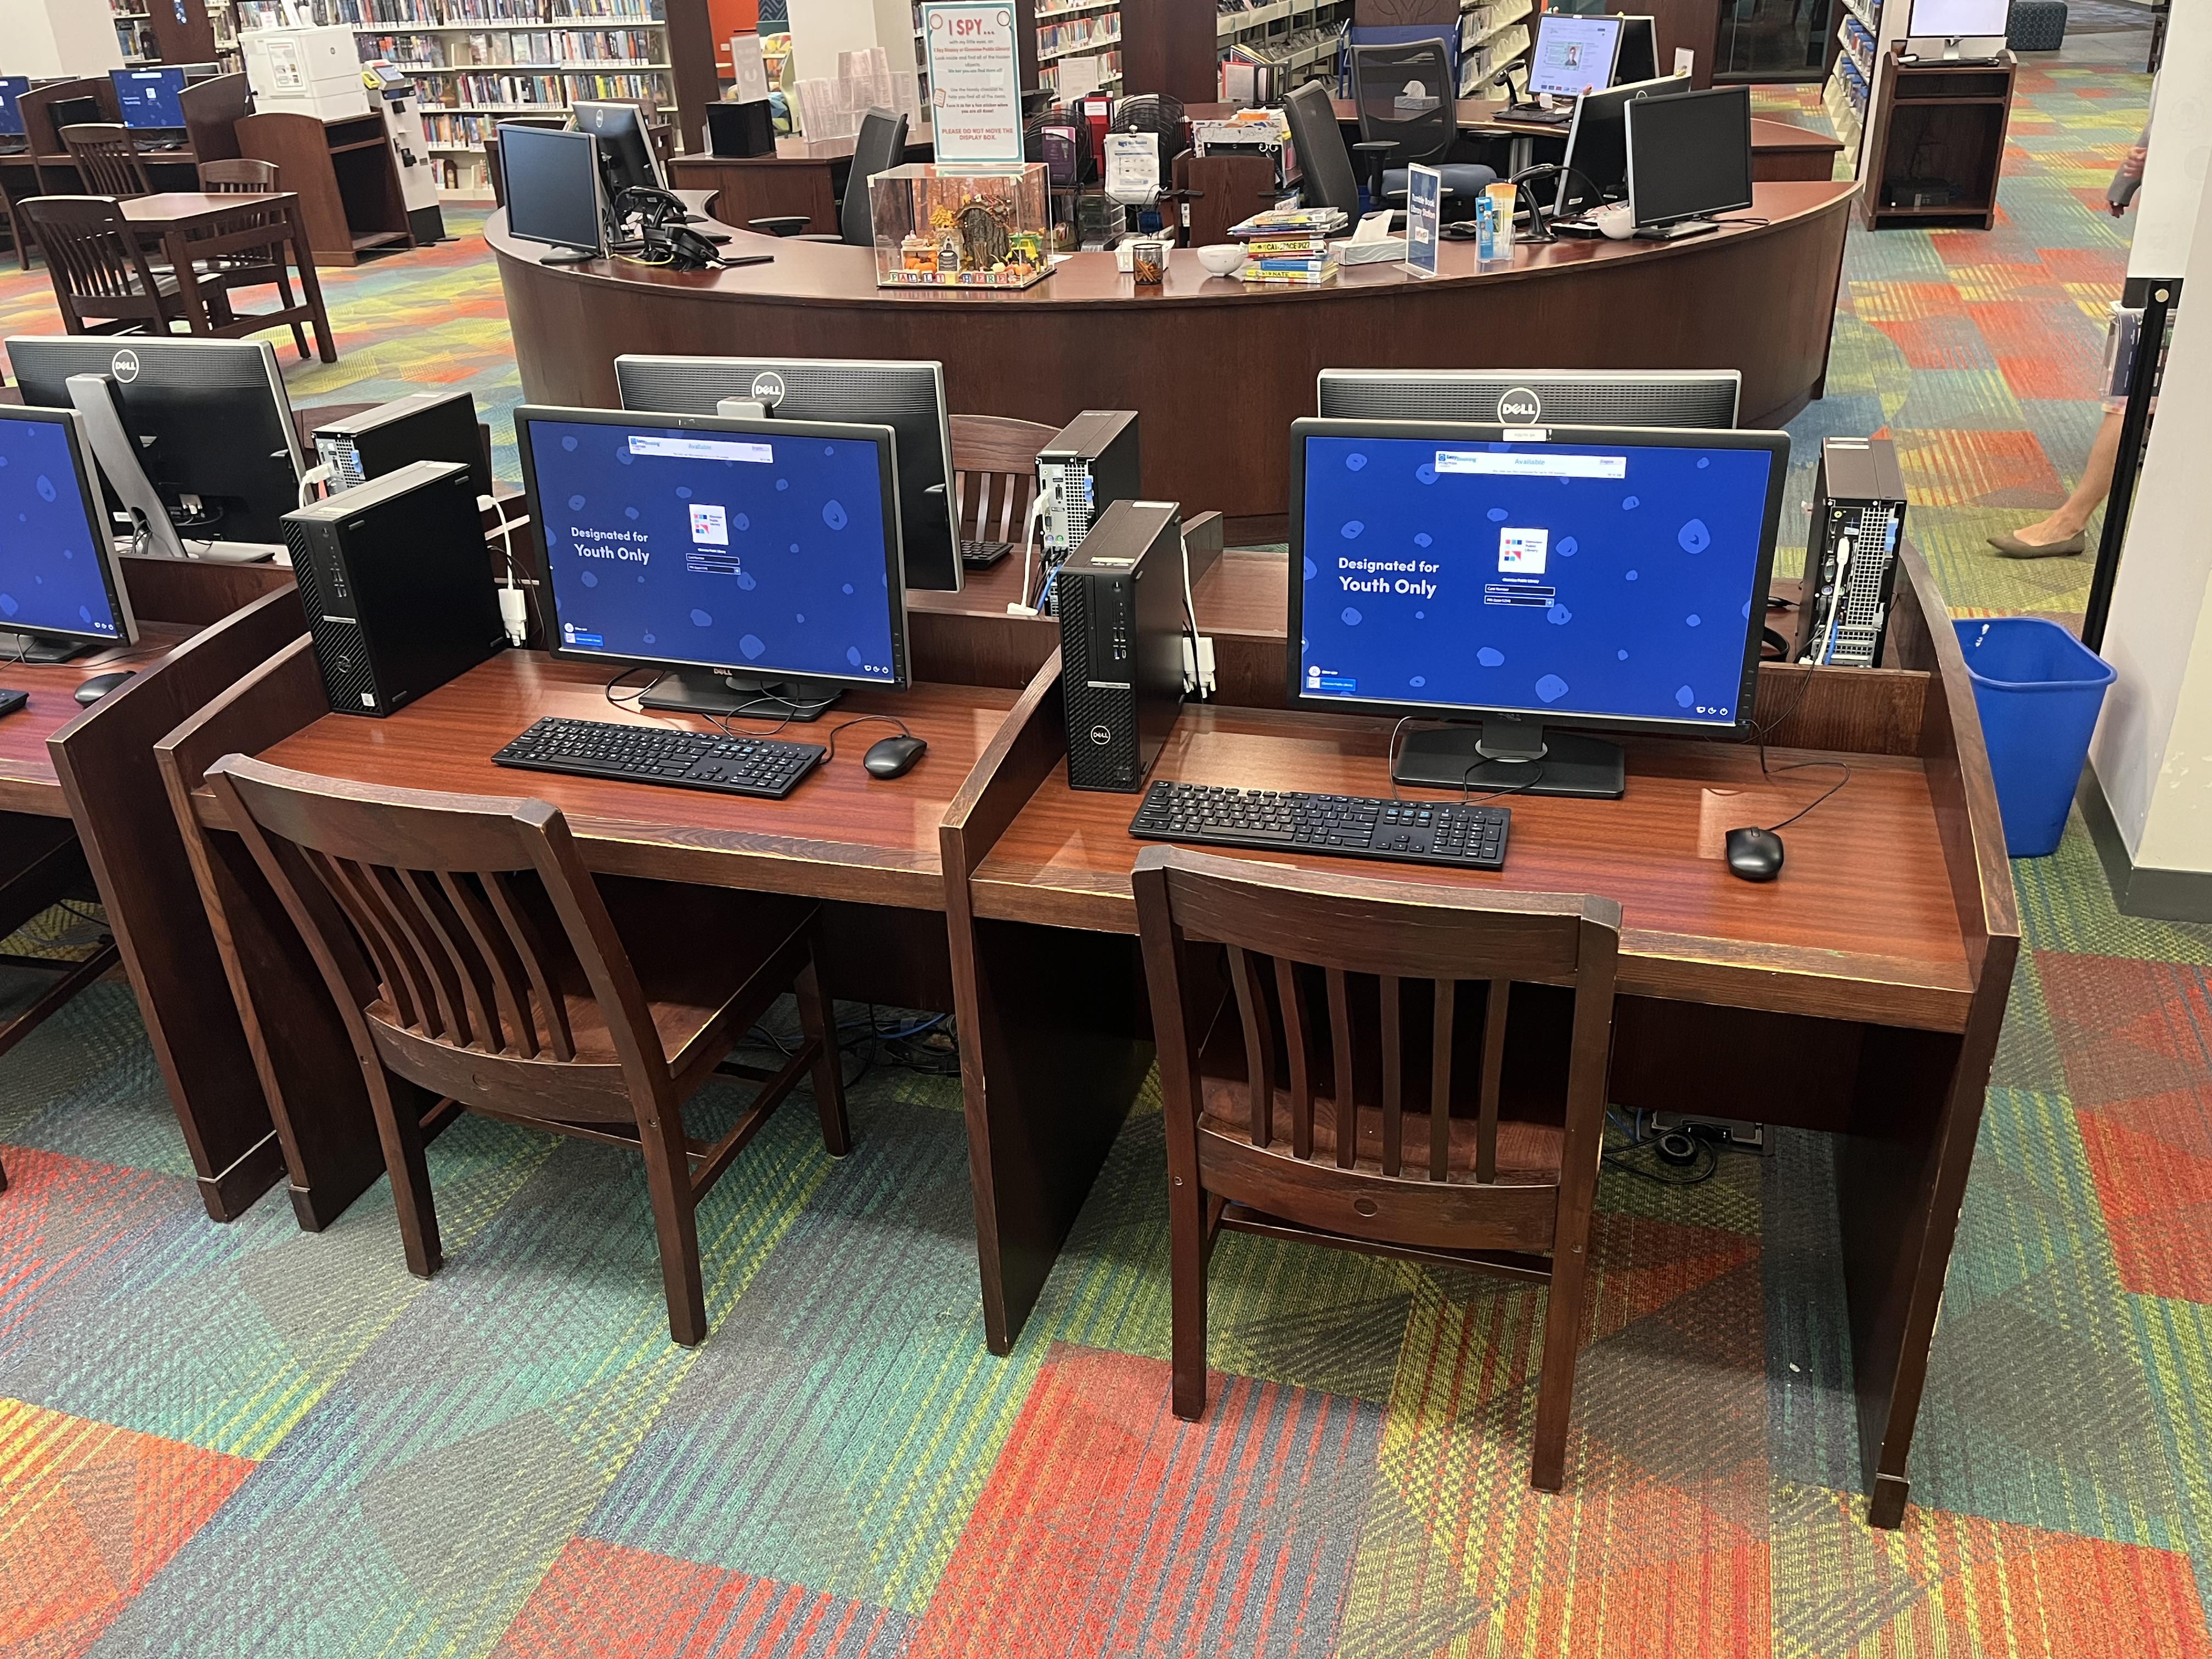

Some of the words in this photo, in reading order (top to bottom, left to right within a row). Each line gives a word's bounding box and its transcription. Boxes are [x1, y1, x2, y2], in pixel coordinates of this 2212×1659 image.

[949, 20, 952, 35] I
[957, 19, 995, 35] SPY...
[1425, 198, 1435, 207] Book
[1423, 208, 1435, 219] Station
[115, 361, 136, 370] DELL
[755, 385, 781, 395] DELL
[1503, 403, 1536, 415] DELL
[571, 527, 630, 541] Designated
[633, 532, 648, 542] for
[574, 543, 614, 559] Youth
[617, 547, 650, 566] Only
[1339, 557, 1416, 573] Designated
[1419, 561, 1440, 573] for
[1339, 576, 1390, 593] Youth
[1395, 579, 1437, 599] Only
